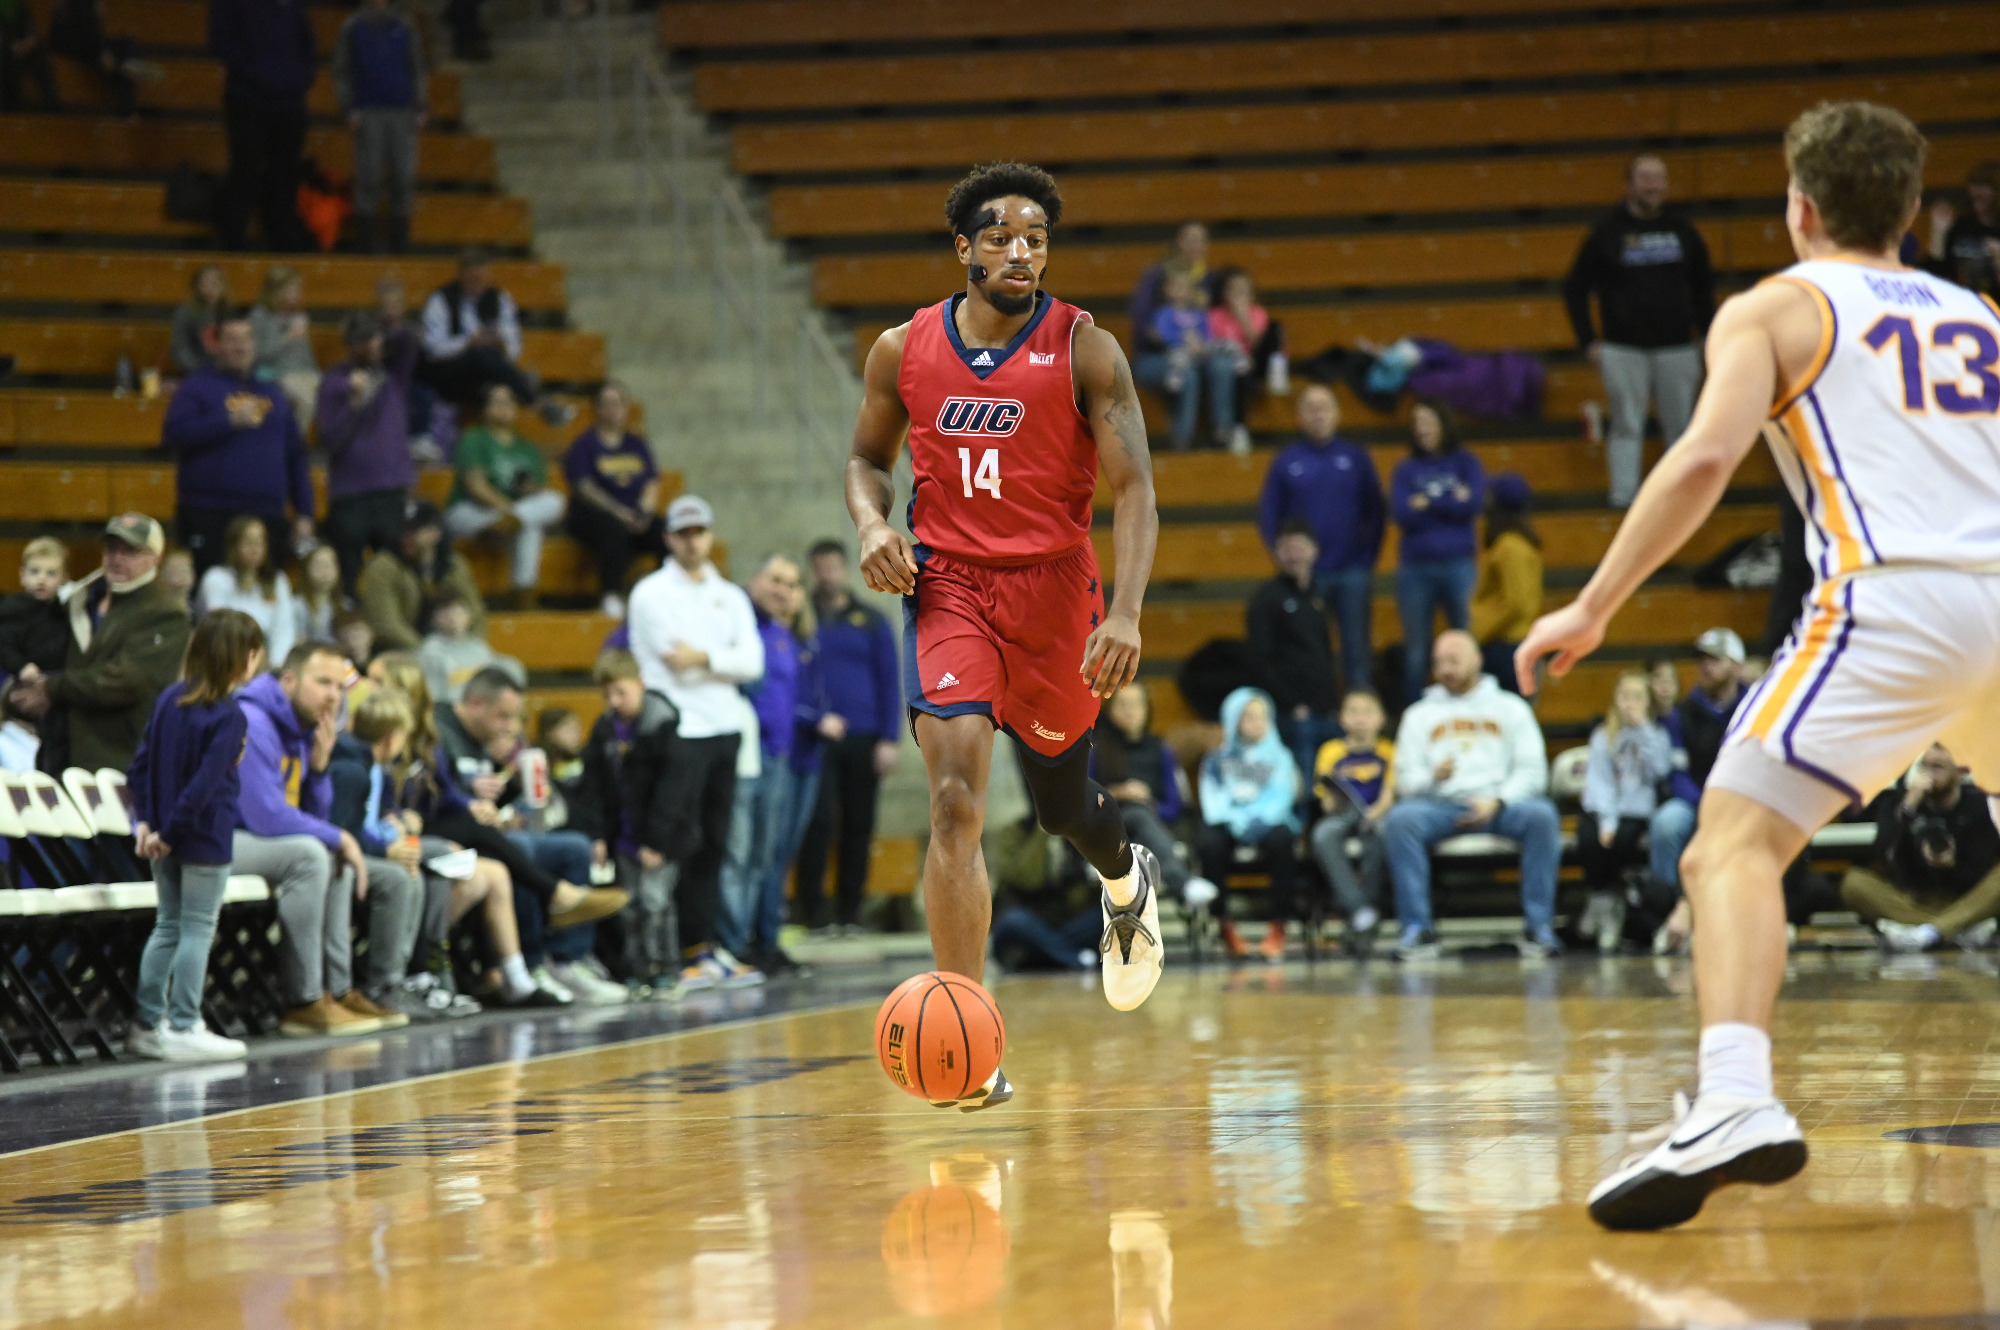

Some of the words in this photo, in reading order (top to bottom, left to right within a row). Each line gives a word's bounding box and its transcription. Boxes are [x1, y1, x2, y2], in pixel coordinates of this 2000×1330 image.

[1029, 351, 1056, 365] VALLEY
[1859, 312, 2000, 417] 13
[938, 400, 1022, 434] UIC
[958, 447, 1002, 499] 14
